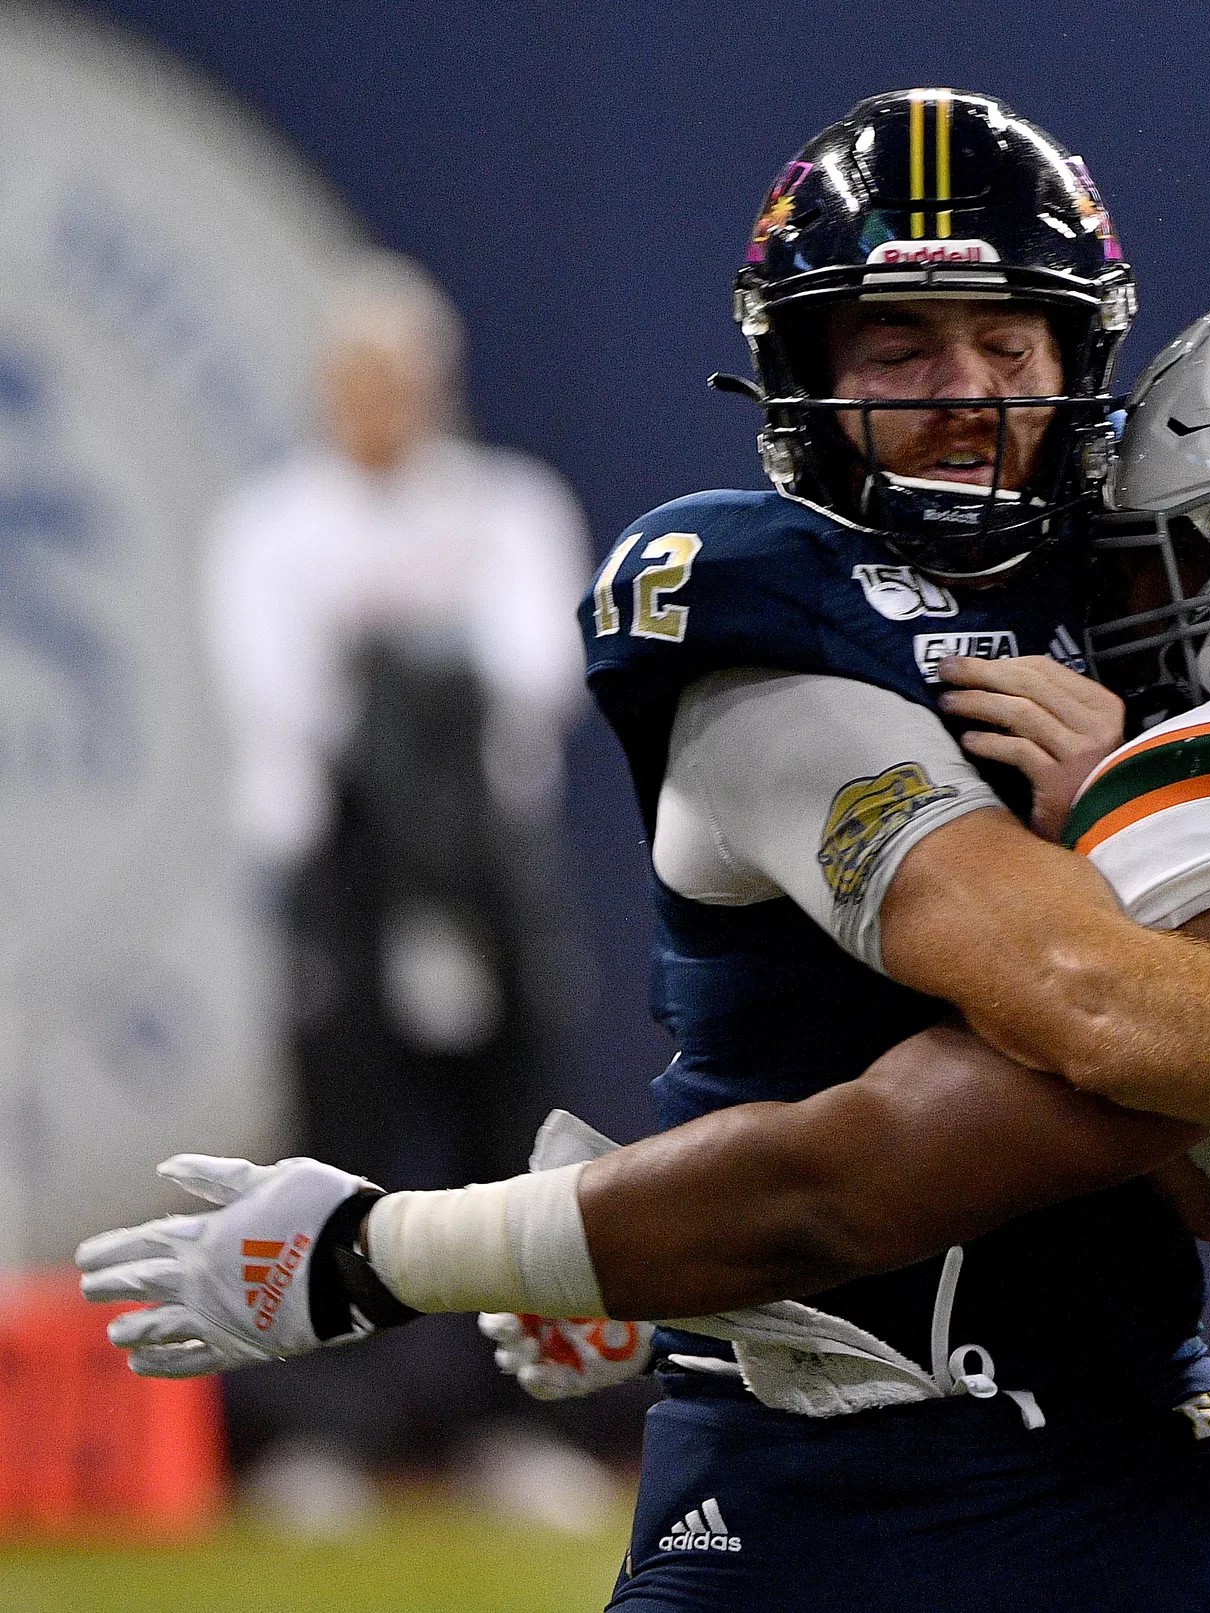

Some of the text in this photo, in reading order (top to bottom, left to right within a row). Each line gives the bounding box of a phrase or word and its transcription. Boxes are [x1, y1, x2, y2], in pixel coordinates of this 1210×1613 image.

[882, 246, 982, 263] Riddell
[592, 531, 703, 643] 12
[252, 1231, 312, 1333] adidas
[658, 1531, 742, 1552] adidas
